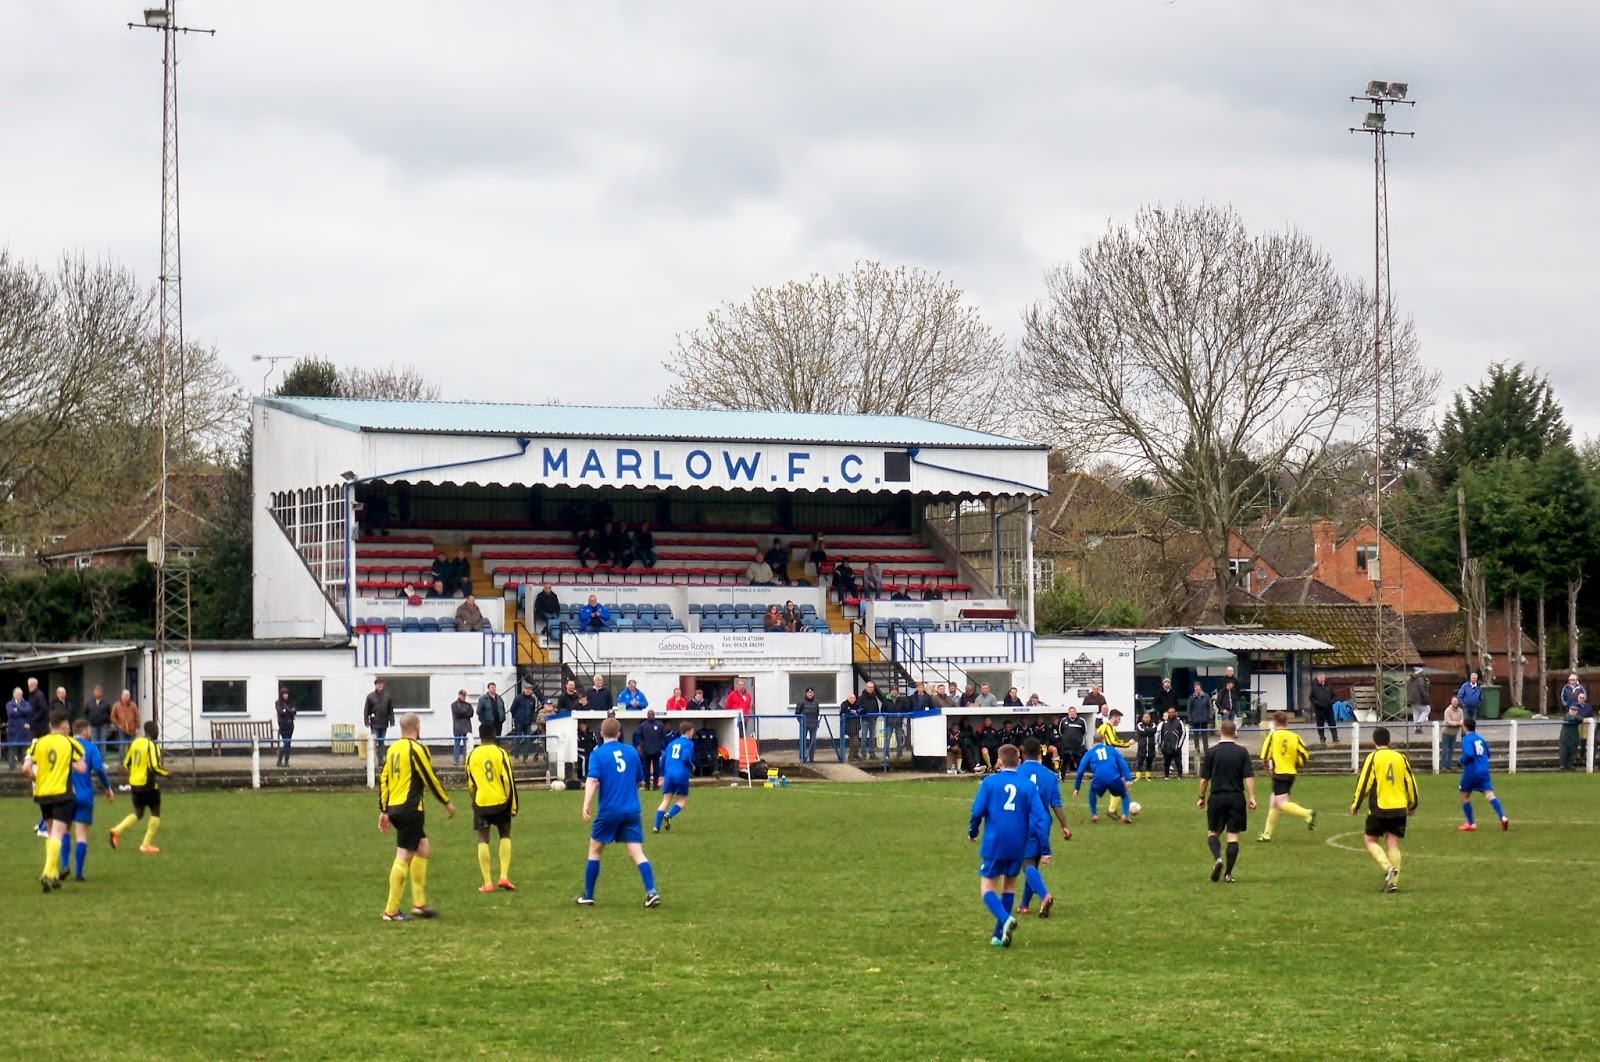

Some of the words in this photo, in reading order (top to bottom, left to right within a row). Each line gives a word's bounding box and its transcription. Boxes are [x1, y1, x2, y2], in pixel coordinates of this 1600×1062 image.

[658, 642, 689, 651] Gabbitas
[690, 642, 715, 651] Robins
[47, 749, 57, 771] 9
[612, 750, 626, 773] 5
[671, 743, 682, 759] 12
[1094, 747, 1108, 761] 11
[390, 753, 401, 779] 14
[483, 760, 494, 783] 8
[1385, 762, 1395, 786] 4
[1003, 783, 1017, 811] 2
